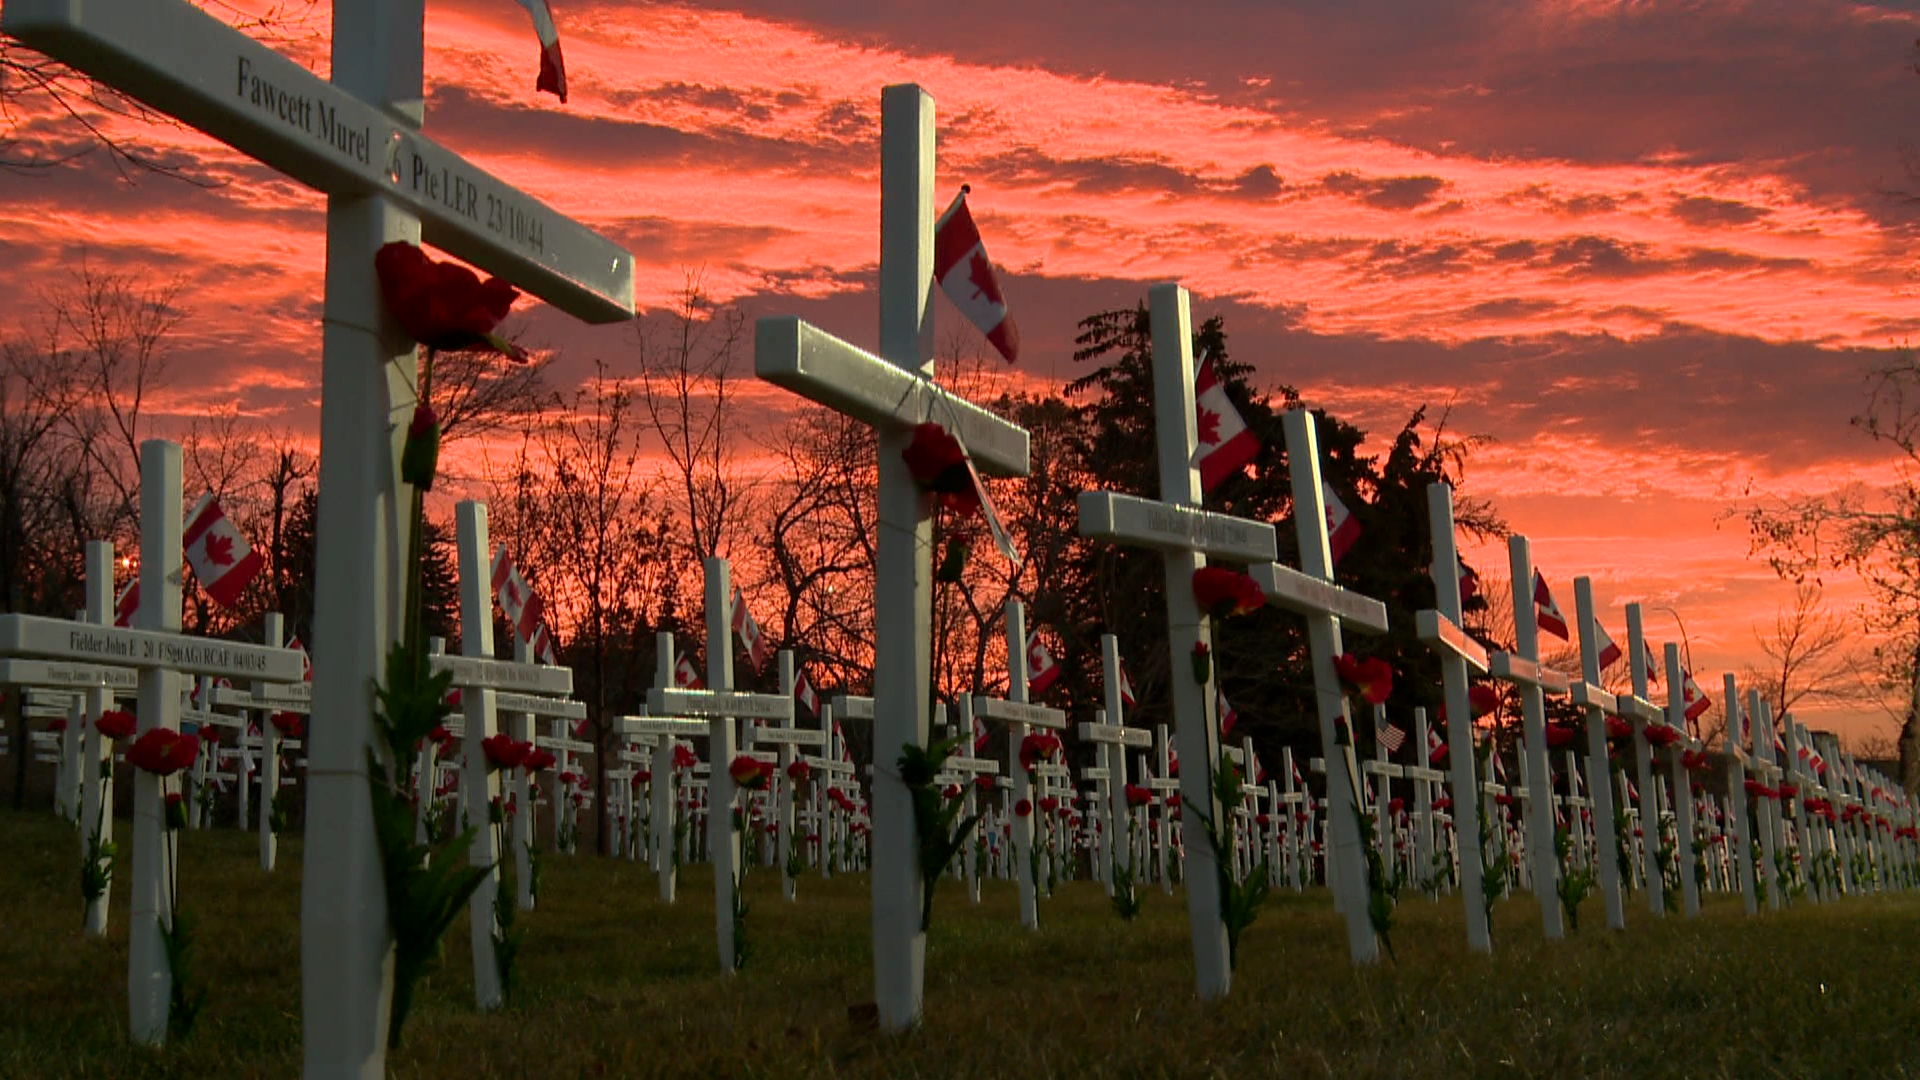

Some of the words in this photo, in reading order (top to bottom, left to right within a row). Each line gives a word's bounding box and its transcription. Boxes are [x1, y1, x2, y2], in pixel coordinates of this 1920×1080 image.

[237, 55, 311, 132] Fawcett
[316, 100, 371, 165] Murel
[486, 192, 544, 255] 23/10/44
[70, 631, 103, 654] Fielder
[104, 635, 127, 656] John
[143, 640, 154, 659] 20
[204, 647, 230, 667] RCAF
